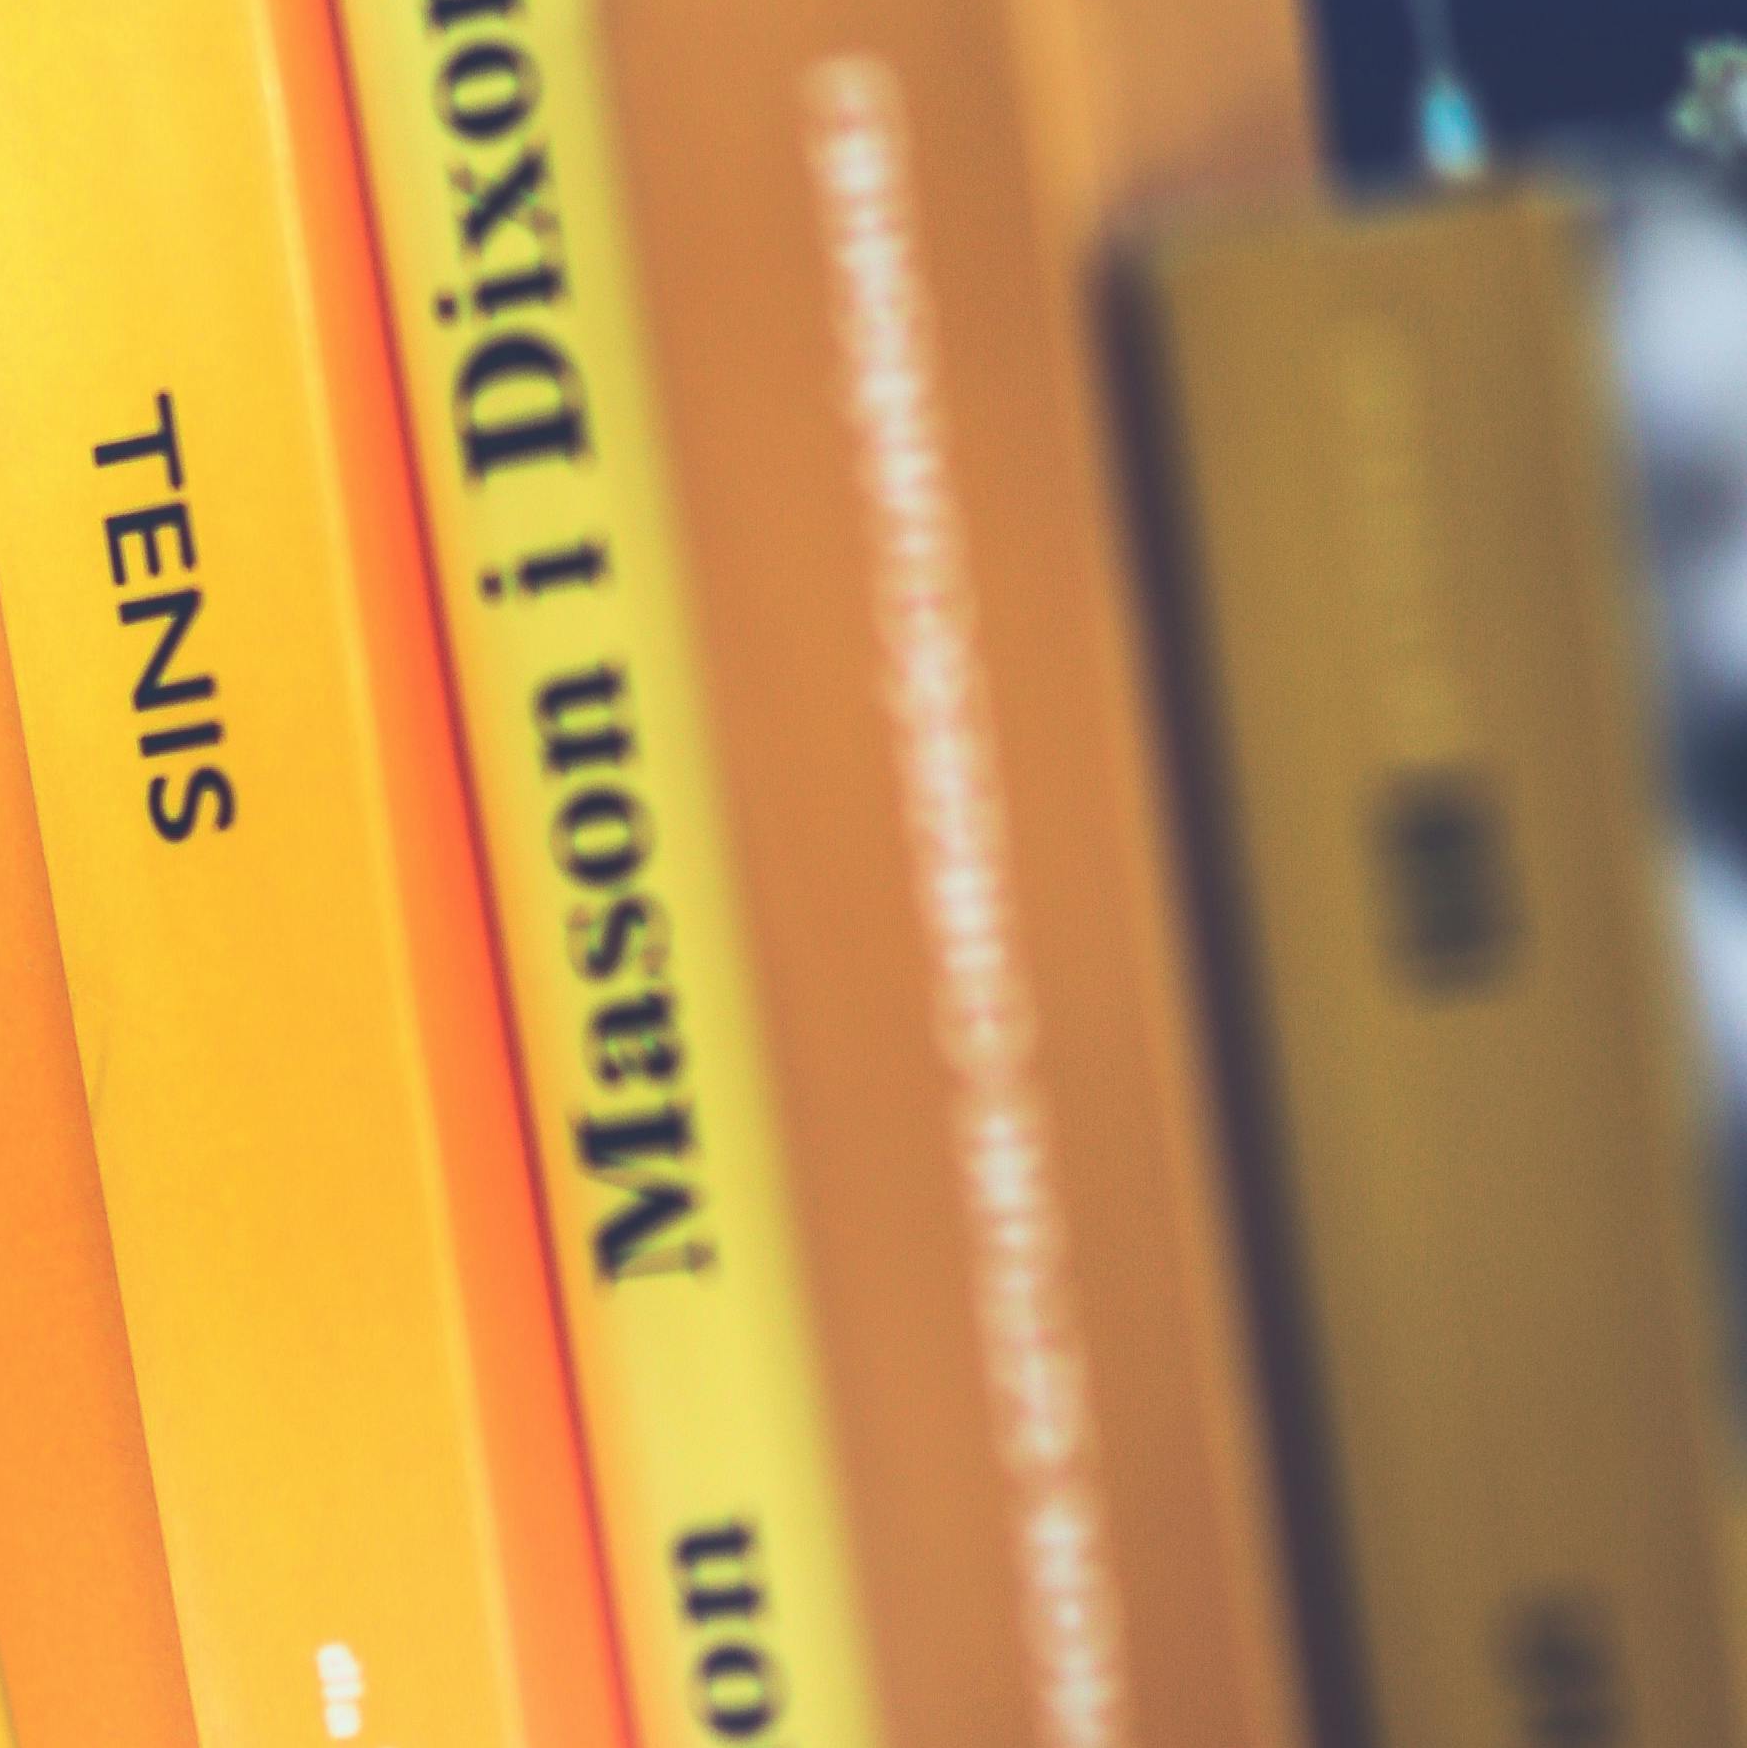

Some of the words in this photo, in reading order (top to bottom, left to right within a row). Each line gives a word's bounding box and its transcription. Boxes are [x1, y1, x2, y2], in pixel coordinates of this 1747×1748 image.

[91, 388, 238, 845] TENIS
[477, 541, 607, 603] i
[532, 663, 719, 1291] Mason
[314, 1640, 365, 1741] dla
